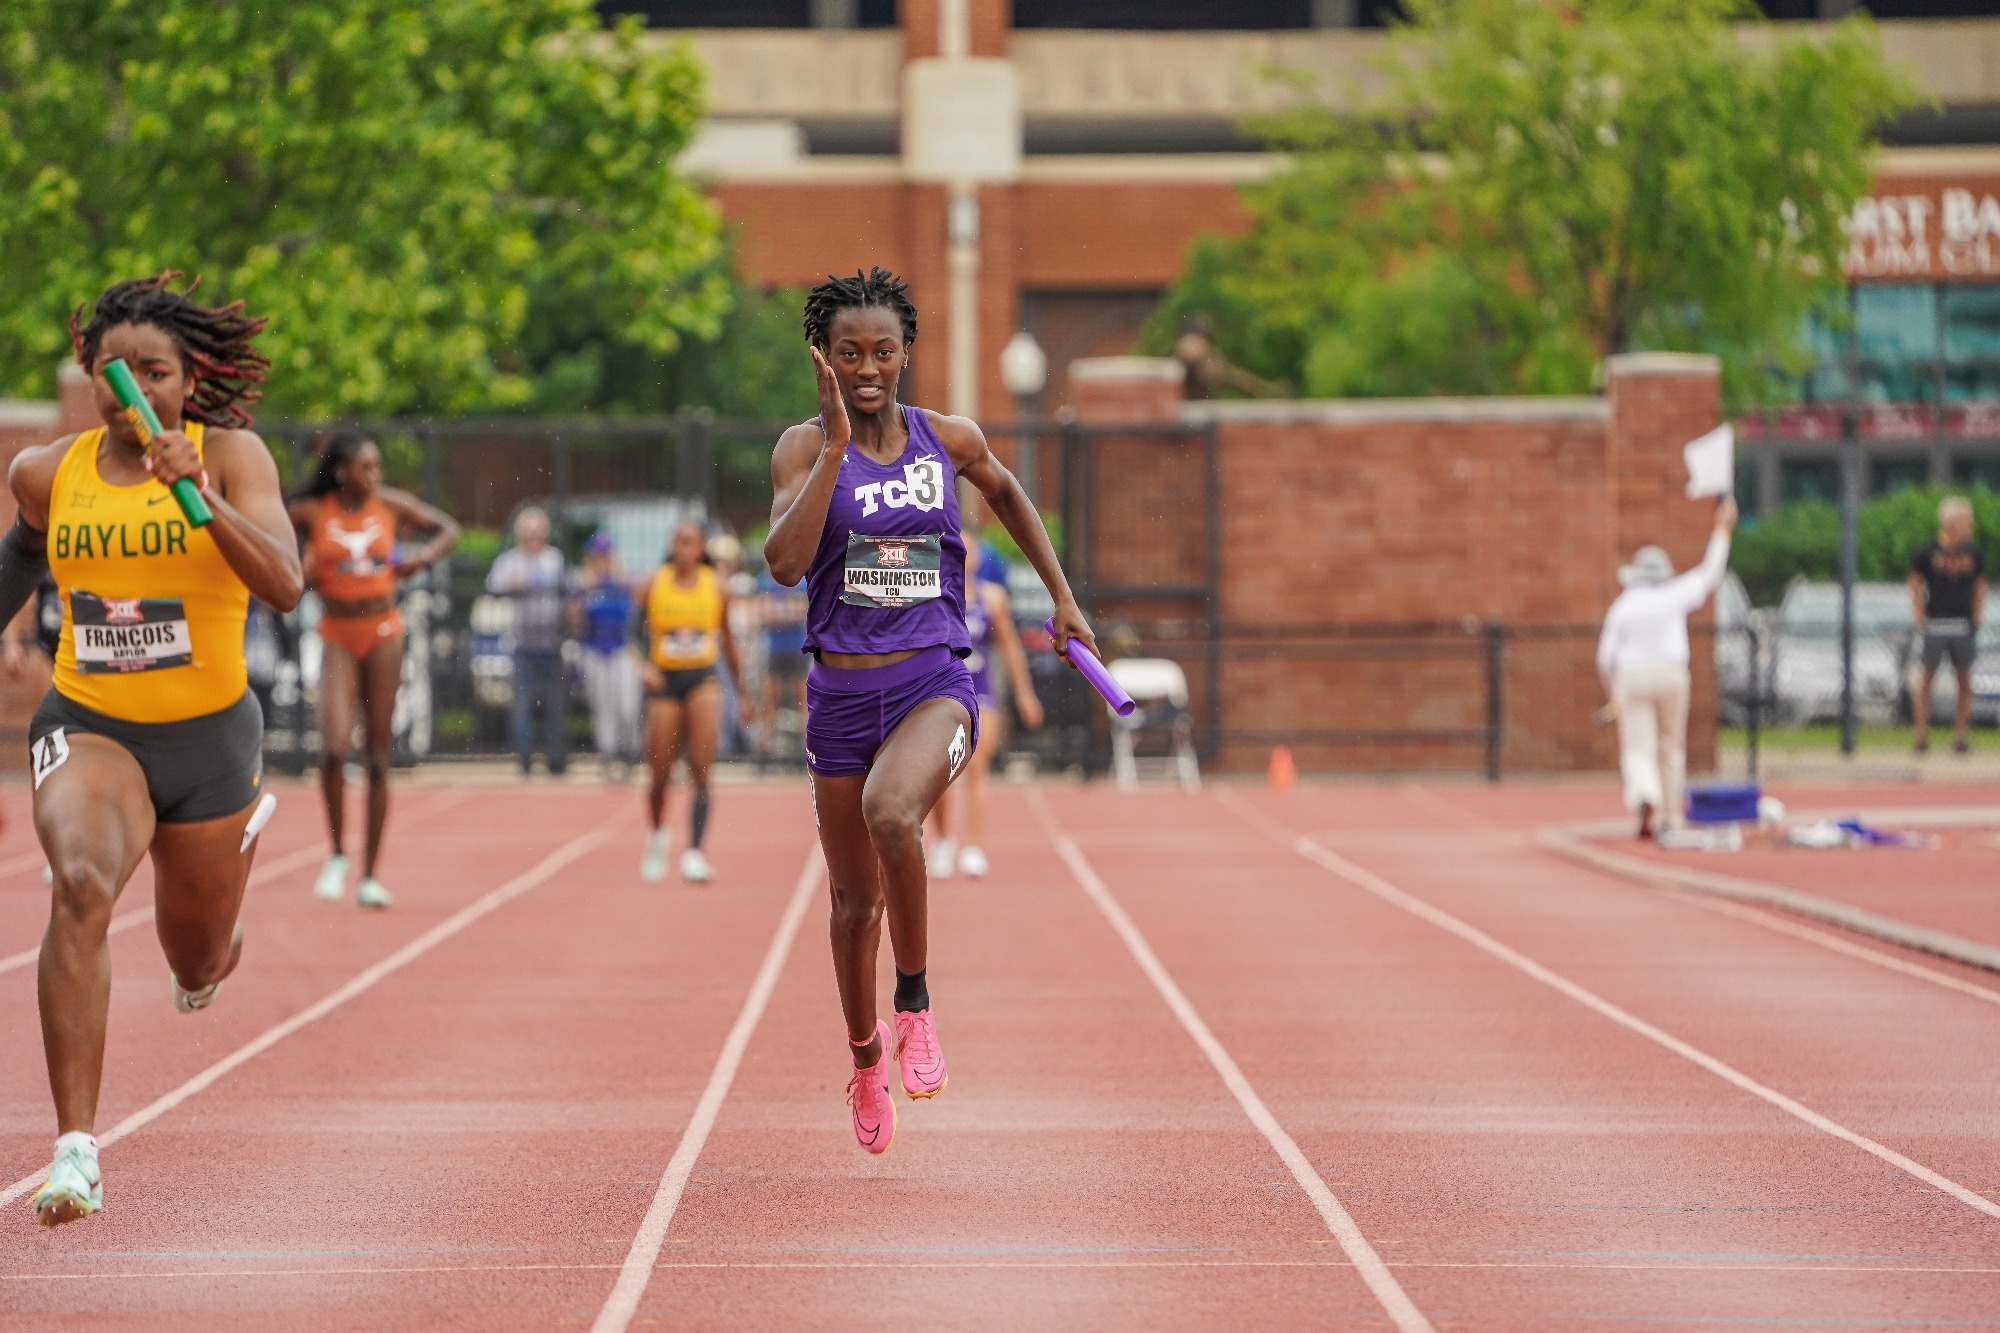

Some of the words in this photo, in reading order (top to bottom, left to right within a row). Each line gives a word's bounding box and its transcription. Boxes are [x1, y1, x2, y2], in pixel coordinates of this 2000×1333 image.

[855, 479, 918, 518] TC
[913, 463, 937, 505] 3
[56, 519, 188, 559] BAYLOR
[847, 570, 936, 587] WASHINGTON
[884, 587, 900, 596] TCU
[85, 624, 175, 648] FRANCOIS
